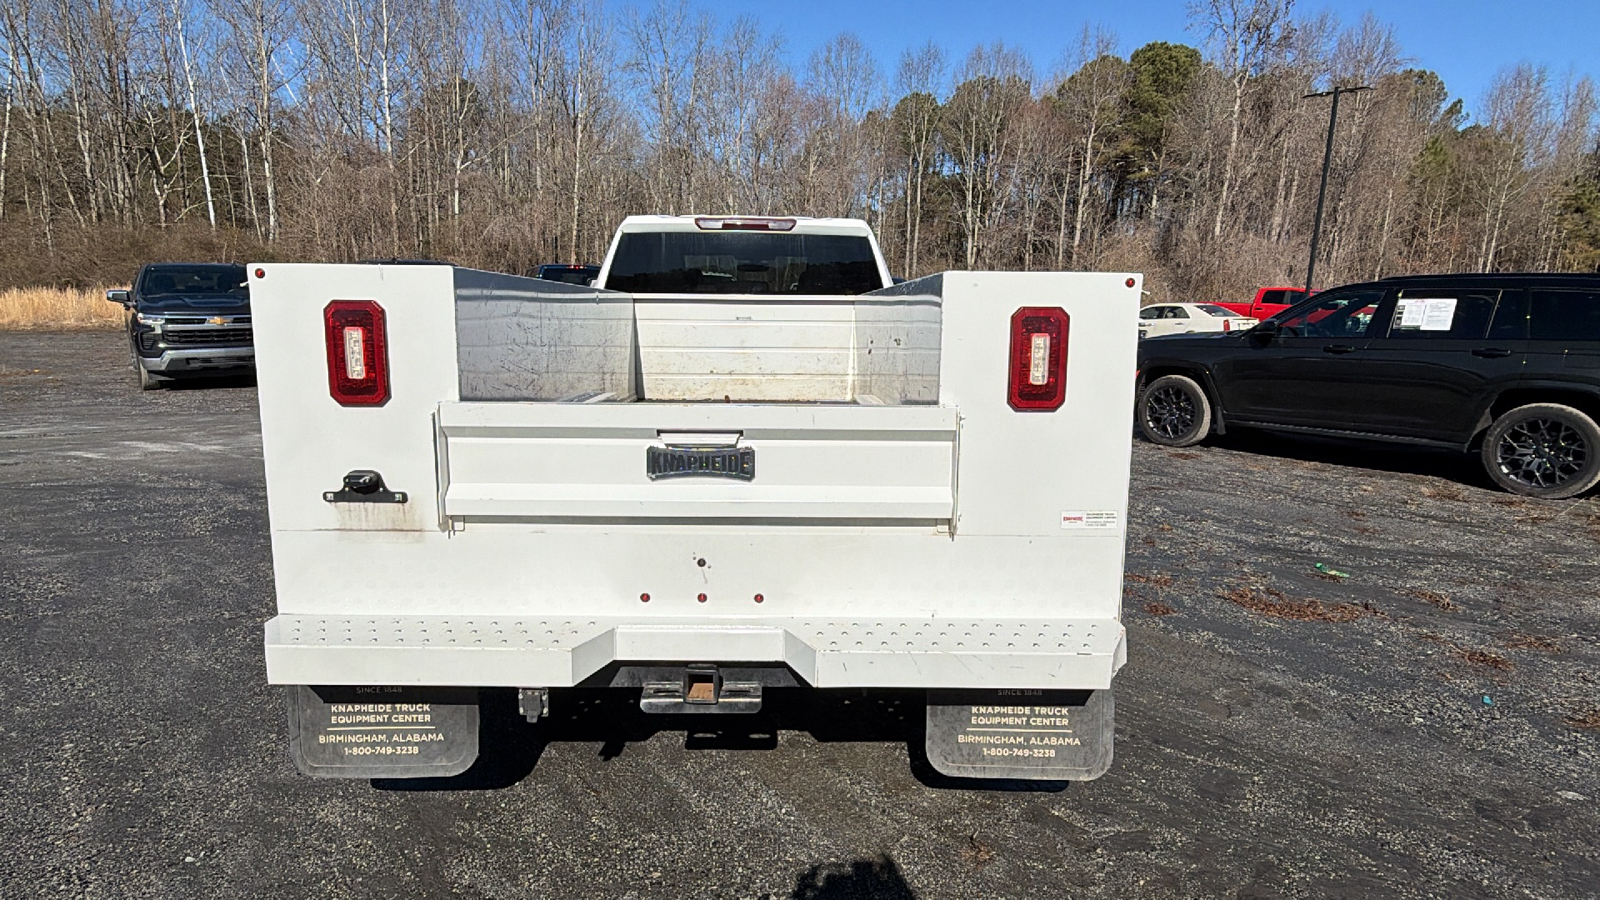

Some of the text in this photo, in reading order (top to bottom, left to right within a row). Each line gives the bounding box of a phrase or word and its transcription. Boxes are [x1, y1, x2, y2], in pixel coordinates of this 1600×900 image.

[650, 450, 752, 475] KNAPHEIDE
[356, 686, 381, 694] SINCE
[331, 703, 431, 713] KNAPHEIDE TRUCK
[971, 706, 1069, 716] KNAPHEIDE TRUCK
[331, 714, 431, 724] EQUIPMENT CENTER
[971, 716, 1069, 726] EQUIPMENT CENTER
[319, 733, 444, 744] BIRMINGHAM, ALABAMA
[957, 734, 1081, 746] BIRMINGHAM, ALABAMA
[344, 746, 419, 756] 1-800-749-3238
[982, 747, 1056, 758] 1-800-749-3238
